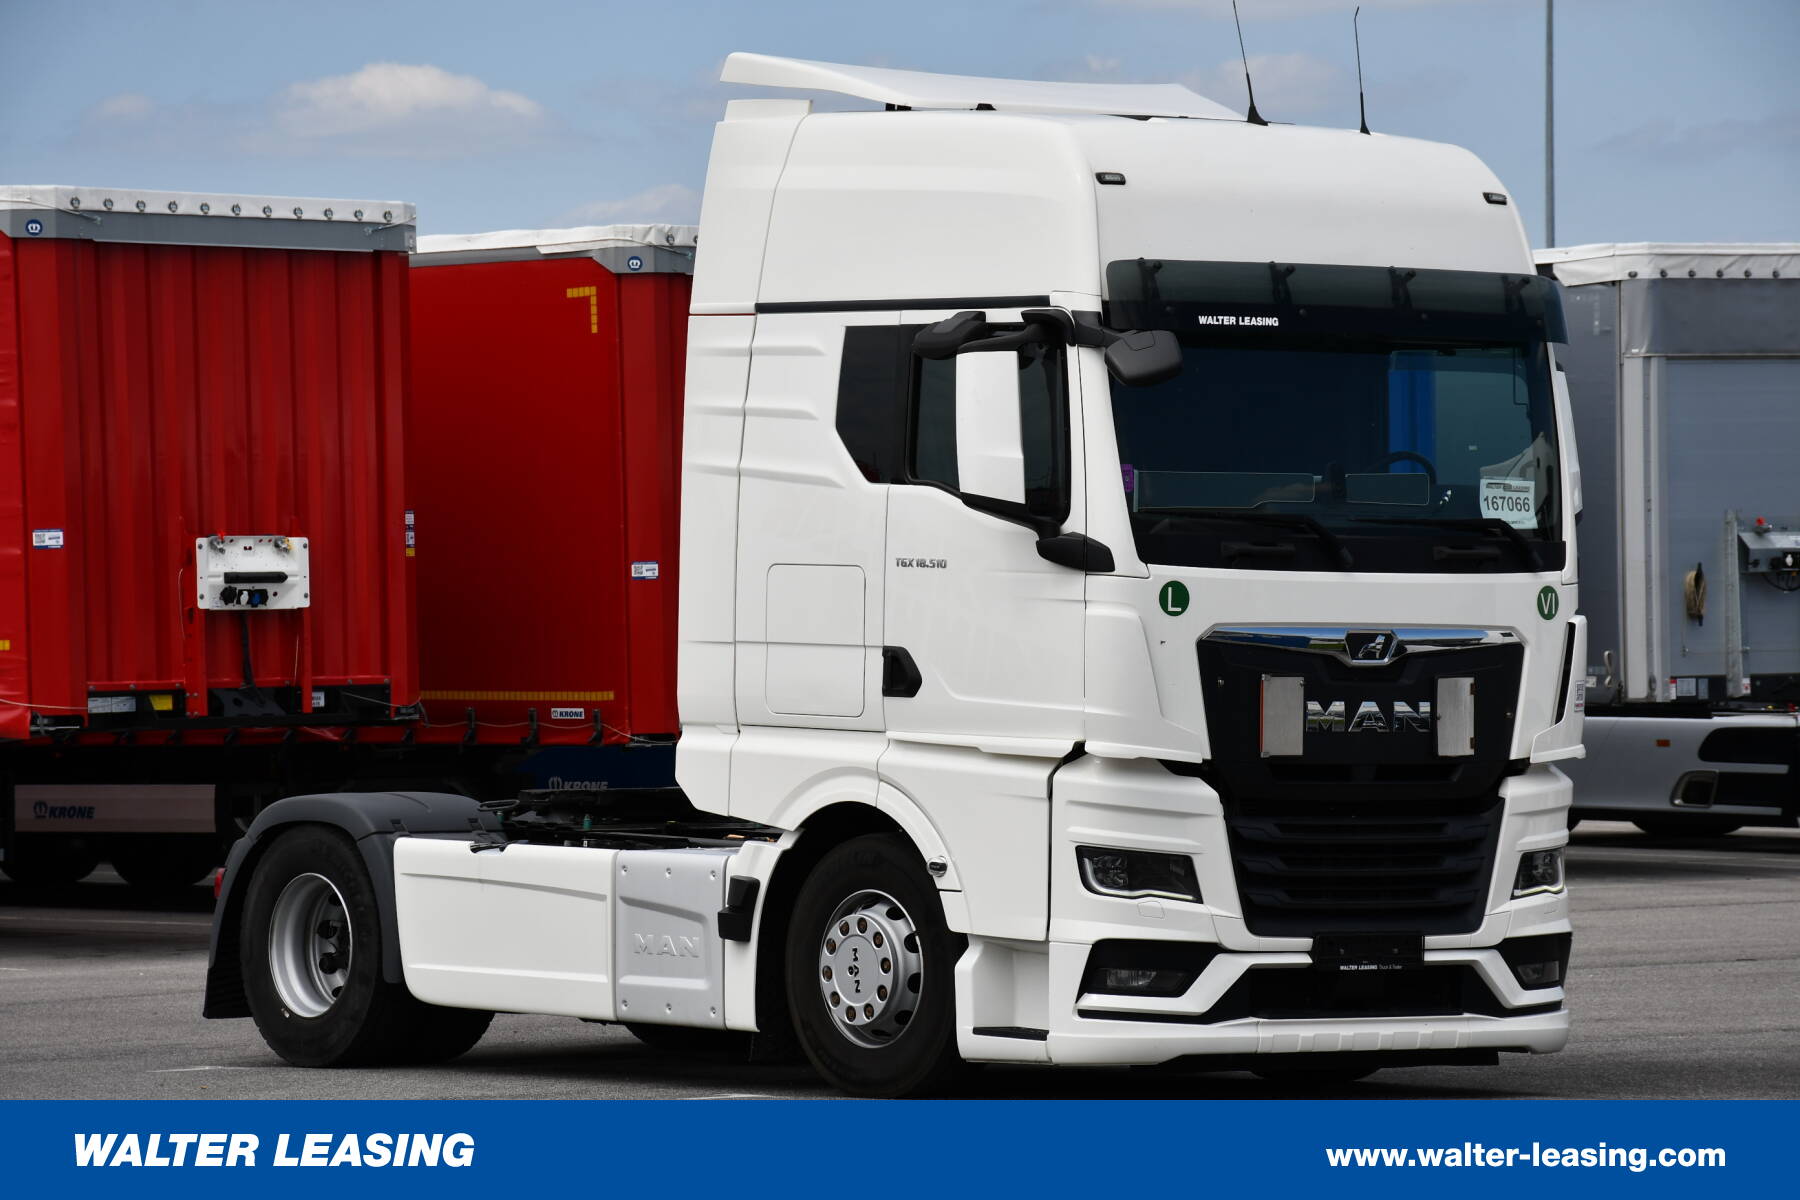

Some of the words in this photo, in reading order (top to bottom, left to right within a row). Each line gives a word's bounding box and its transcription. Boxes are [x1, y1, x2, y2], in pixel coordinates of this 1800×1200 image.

[1198, 315, 1236, 325] WALTER
[1238, 316, 1279, 326] LEASING
[1483, 495, 1530, 512] 167066
[896, 557, 914, 568] TGX
[915, 558, 947, 568] 18.510
[1167, 586, 1182, 612] L
[1540, 592, 1556, 615] VI
[560, 710, 583, 718] KRONE
[1306, 701, 1431, 732] MAN
[49, 806, 96, 819] KRONE
[632, 933, 700, 958] MAN
[852, 947, 861, 993] MAN
